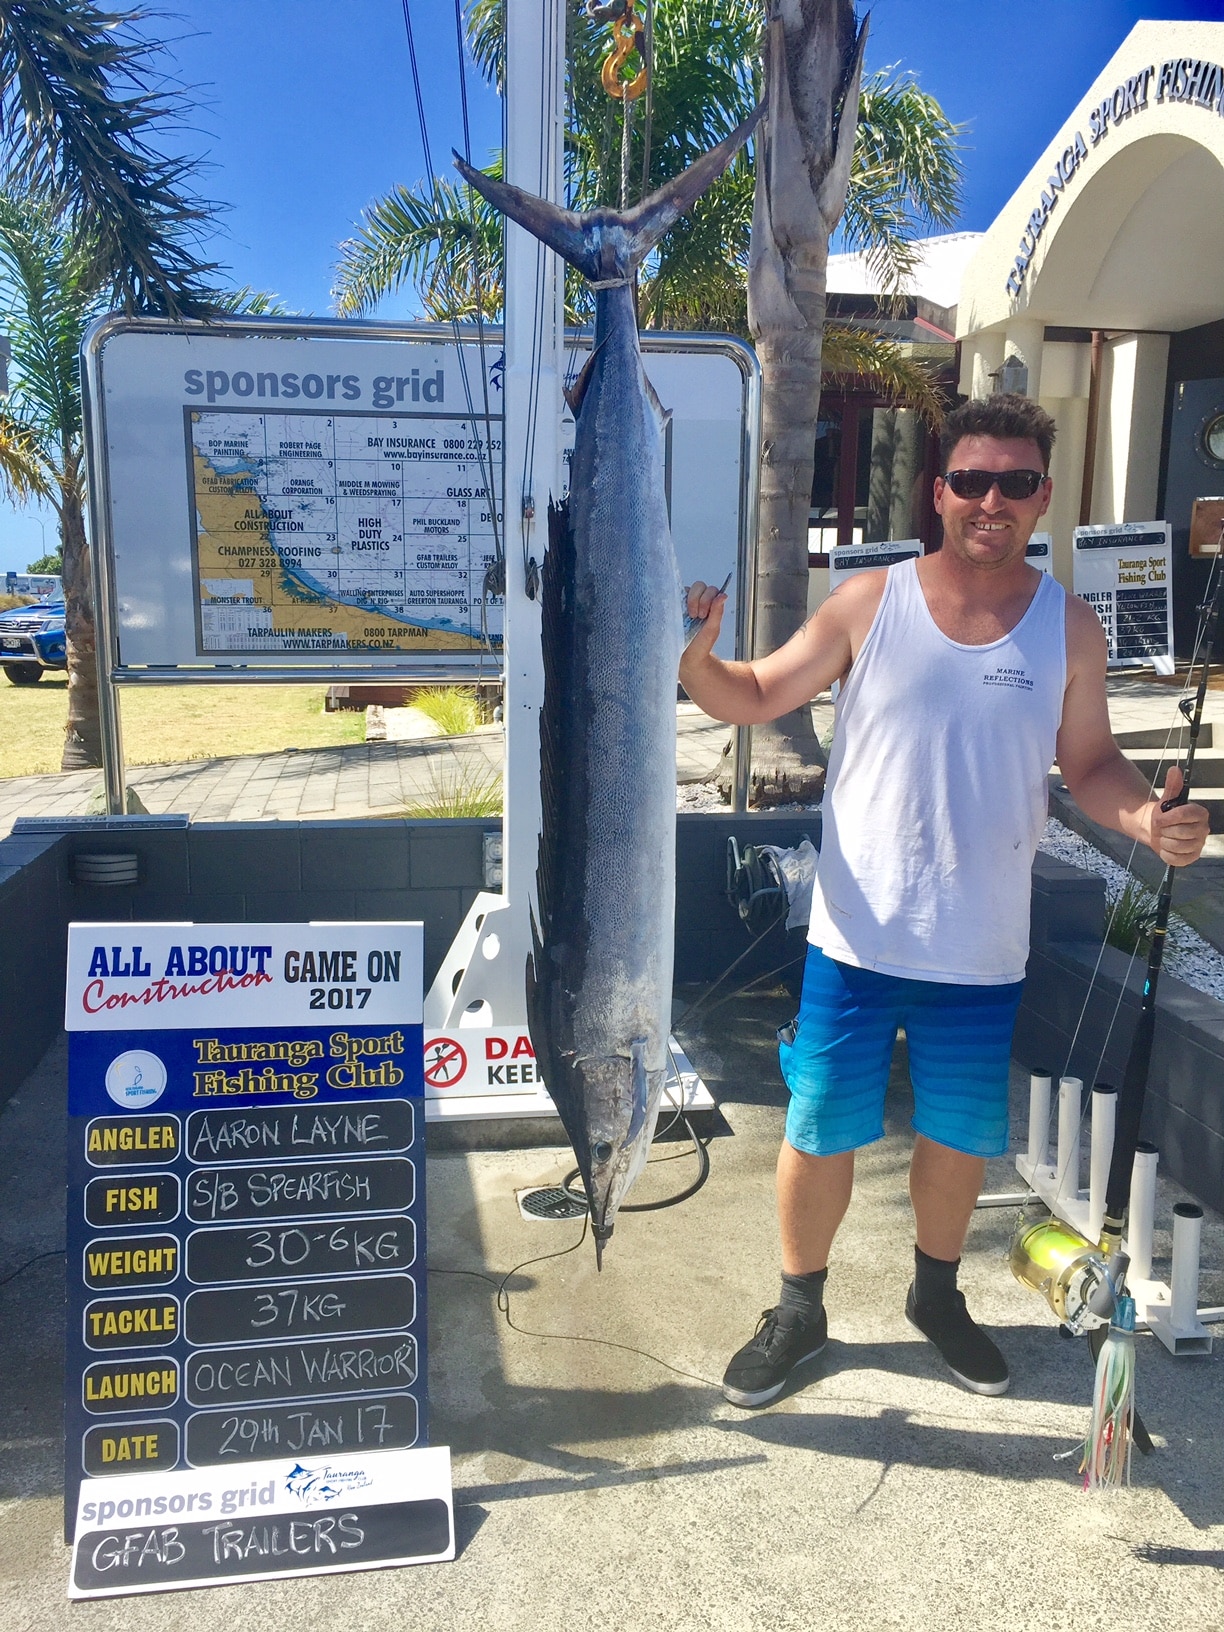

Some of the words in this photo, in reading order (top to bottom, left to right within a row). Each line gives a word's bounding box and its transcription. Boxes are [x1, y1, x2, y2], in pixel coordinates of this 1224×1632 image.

[1005, 131, 1088, 297] TAURANGA
[1088, 65, 1155, 143] SPORT
[184, 369, 361, 403] sponsors
[372, 369, 444, 409] grid
[258, 417, 264, 425] 1
[327, 419, 333, 427] 2
[392, 421, 398, 429] 3
[208, 440, 222, 448] BOP
[224, 440, 249, 448] MARINE
[305, 442, 322, 450] PAGE
[367, 437, 384, 448] BAY
[386, 438, 436, 449] INSURANCE
[443, 439, 465, 450] 0800
[468, 440, 483, 450] 229
[279, 450, 323, 458] ENGINEERING
[457, 464, 466, 472] 11
[220, 478, 259, 486] FABRICATION
[338, 480, 363, 488] MIDDLE
[350, 489, 397, 497] WEEDSPRAYING
[446, 488, 472, 498] GLASS
[457, 500, 467, 508] 18
[244, 510, 261, 519] ALL
[262, 510, 294, 520] ABOUT
[234, 521, 304, 532] CONSTRUCTION
[358, 518, 382, 528] HIGH
[412, 518, 427, 526] PHIL
[359, 530, 382, 540] DUTY
[424, 526, 450, 534] MOTORS
[1109, 527, 1122, 535] grid
[326, 534, 336, 542] 23
[392, 534, 402, 542] 24
[1097, 536, 1144, 547] INSURANCE
[351, 540, 390, 551] PLASTICS
[218, 546, 275, 557] CHAMPNESS
[278, 547, 322, 558] ROOFING
[834, 548, 864, 556] sponsors
[865, 546, 879, 555] grid
[238, 558, 255, 568] 027
[259, 558, 276, 568] 328
[416, 554, 432, 562] GFAB
[432, 554, 458, 562] TRAILERS
[416, 562, 440, 570] CUSTOM
[1118, 558, 1148, 571] Tauranga
[1148, 556, 1166, 570] Sport
[260, 570, 270, 578] 29
[327, 570, 338, 578] 30
[1118, 572, 1146, 586] Fishing
[1148, 570, 1166, 581] Club
[1078, 592, 1112, 602] NGLER
[328, 606, 338, 614] 37
[394, 606, 404, 614] 38
[458, 606, 468, 614] 39
[1093, 604, 1112, 613] ISH
[247, 628, 294, 638] TARPAULIN
[298, 628, 333, 638] MAKERS
[364, 628, 385, 638] 0800
[388, 628, 428, 638] TARPMAN
[282, 640, 395, 650] WWW.TARPMAKERS.CO.NZ
[996, 668, 1026, 676] MARINE
[984, 675, 1034, 686] REFLECTIONS
[88, 946, 151, 978] ALL
[165, 946, 272, 978] ABOUT
[284, 950, 357, 983] GAME
[368, 950, 401, 982] ON
[82, 968, 274, 1014] Construction
[309, 988, 372, 1010] 2017
[192, 1038, 324, 1067] Tauranga
[329, 1030, 404, 1063] Sport
[485, 1036, 537, 1060] DA
[192, 1067, 318, 1099] Fishing
[326, 1060, 404, 1090] Club
[88, 1126, 176, 1152] ANGLER
[194, 1114, 281, 1156] AARON
[292, 1114, 389, 1146] LAYNE
[106, 1186, 158, 1213] FISH
[192, 1173, 239, 1219] S/B
[248, 1170, 371, 1207] SPEARFISH
[88, 1248, 176, 1276] WEIGHT
[250, 1290, 346, 1328] 37KG
[90, 1306, 176, 1337] TACKLE
[194, 1356, 292, 1392] OCEAN
[300, 1344, 416, 1384] WARRIOR
[86, 1369, 176, 1400] LAUNCH
[218, 1416, 280, 1455] 29th
[288, 1411, 344, 1451] JAN
[356, 1404, 394, 1445] 17
[102, 1434, 159, 1463] DATE
[323, 1466, 365, 1480] Tauranga
[82, 1488, 213, 1525] sponsors
[220, 1480, 276, 1511] grid
[92, 1526, 186, 1572] GFAB
[202, 1512, 366, 1564] TRAILERS
